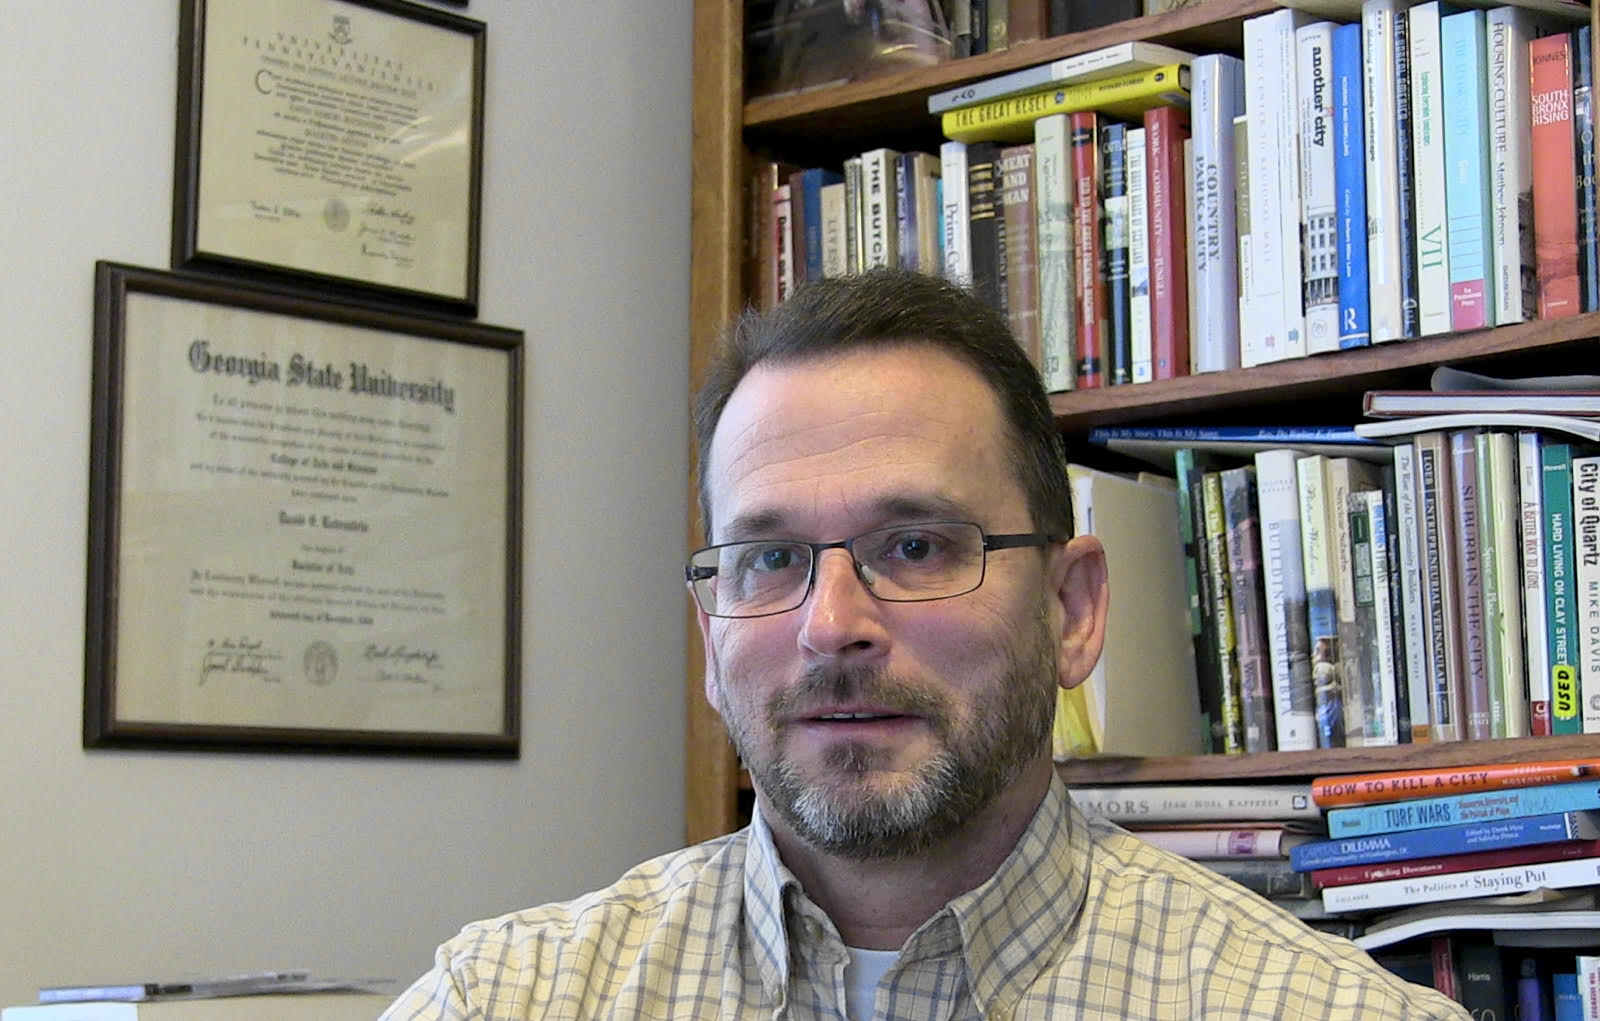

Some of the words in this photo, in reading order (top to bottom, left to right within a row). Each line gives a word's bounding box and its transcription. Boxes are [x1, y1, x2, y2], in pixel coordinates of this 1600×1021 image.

[1394, 19, 1407, 37] THE
[1492, 22, 1505, 87] HOUSING
[1312, 46, 1326, 112] another
[955, 112, 974, 128] THE
[979, 105, 1011, 124] GREAT
[1015, 95, 1048, 116] RESET
[1532, 91, 1568, 105] SOUTH
[1532, 101, 1569, 116] BRONX
[1312, 115, 1327, 148] city
[1494, 87, 1507, 153] CULTURE
[1533, 112, 1569, 126] RISING
[1151, 122, 1161, 155] WORK
[871, 158, 881, 195] THE
[1195, 156, 1206, 208] PARK
[1239, 162, 1251, 188] City
[1496, 161, 1507, 206] Matthew
[1152, 169, 1163, 236] COMMUNITY
[1207, 164, 1220, 260] COUNTRY
[945, 202, 958, 248] Prime
[1496, 207, 1508, 247] Johnson
[1196, 225, 1207, 273] CITY
[1420, 224, 1443, 270] VII
[1155, 256, 1165, 297] JUNGLE
[188, 339, 281, 388] Georgia
[286, 352, 343, 393] State
[349, 361, 456, 415] University
[1423, 456, 1433, 485] LOEB
[1579, 462, 1598, 493] City
[1581, 496, 1599, 512] of
[1462, 485, 1478, 562] SUBURB
[1523, 510, 1537, 536] BETTER
[1551, 513, 1563, 542] HARD
[1425, 498, 1441, 606] ENTREPRENEURIAL
[1524, 539, 1538, 555] WAY
[1580, 514, 1600, 567] Quartz
[1268, 521, 1286, 613] BUILDING
[1466, 567, 1478, 586] IN
[1481, 547, 1495, 574] Space
[1553, 545, 1565, 577] LIVING
[1554, 580, 1565, 595] ON
[1588, 581, 1600, 619] MIKE
[1468, 592, 1481, 628] THE
[1487, 592, 1497, 618] Place
[1555, 598, 1567, 625] CLAY
[1431, 609, 1447, 687] VERNACULAR
[1470, 635, 1485, 680] CITY
[1556, 627, 1568, 664] STREET
[1590, 626, 1600, 673] DAVIS
[1275, 623, 1292, 717] SUBURBIA
[1557, 669, 1571, 712] USED
[1322, 782, 1357, 797] HOW
[1364, 780, 1385, 793] TO
[1391, 777, 1428, 791] KILL
[1434, 777, 1444, 787] A
[1449, 772, 1489, 786] CITY
[1079, 799, 1151, 816] MORS
[1385, 807, 1414, 829] TURF
[1417, 802, 1451, 824] WARS
[1341, 838, 1391, 854] DILEMMA
[1404, 885, 1420, 895] The
[1422, 882, 1458, 893] Politics
[1459, 880, 1469, 889] of
[1473, 873, 1522, 892] Staying
[1525, 870, 1548, 884] Put
[1467, 971, 1491, 982] Harris
